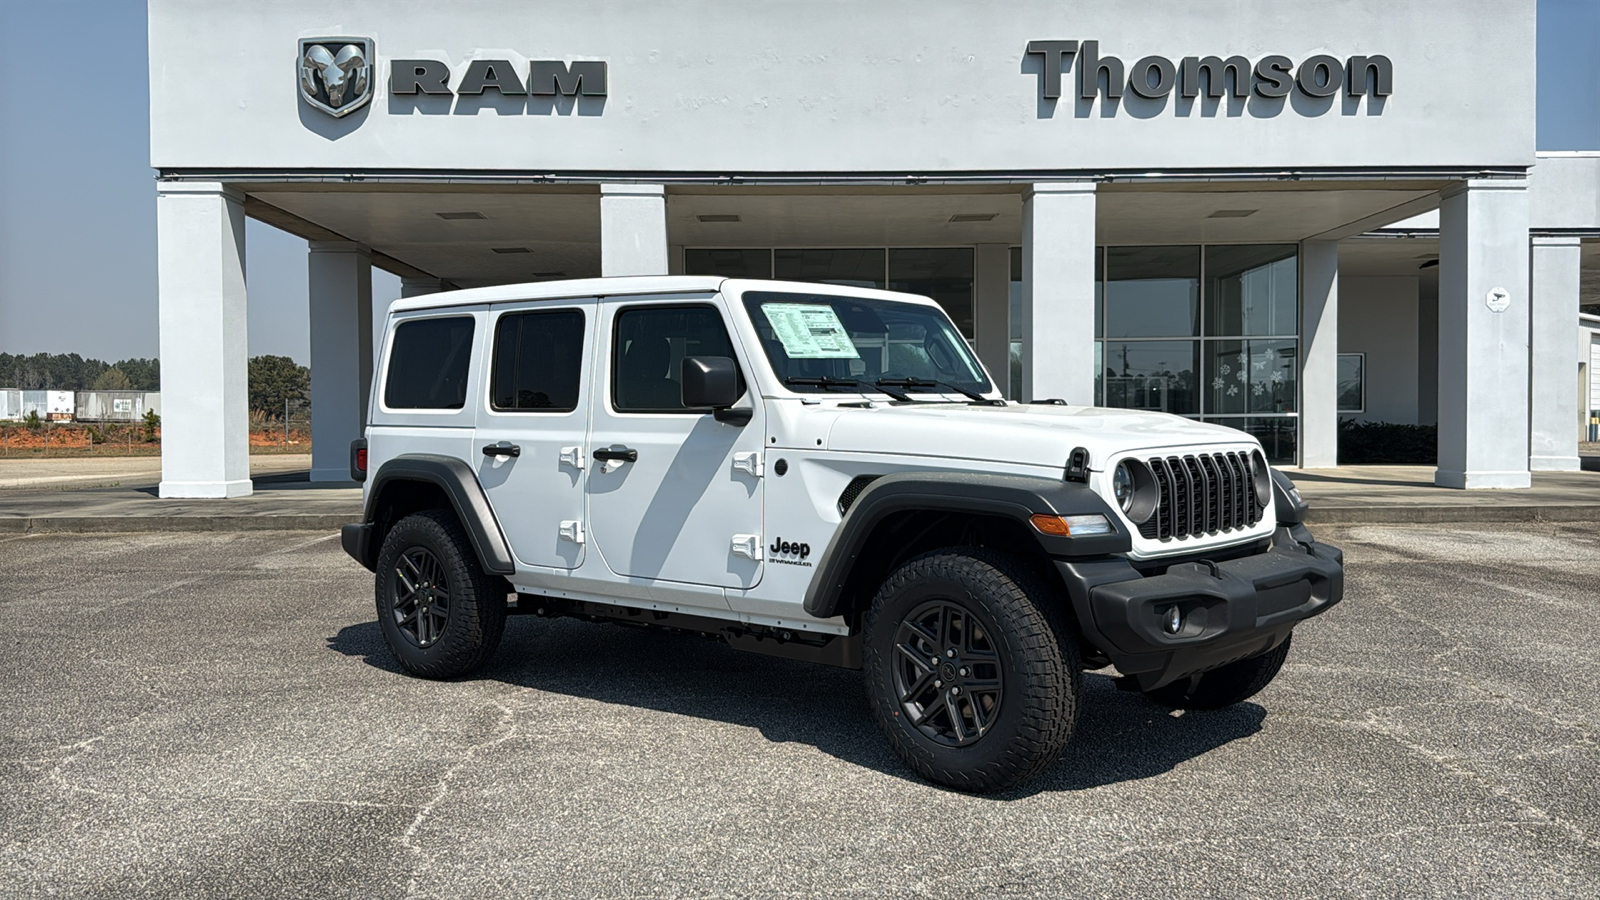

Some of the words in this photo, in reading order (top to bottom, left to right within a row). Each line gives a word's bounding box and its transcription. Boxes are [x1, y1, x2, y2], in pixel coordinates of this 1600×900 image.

[390, 59, 607, 96] RAM
[1027, 40, 1393, 99] Thomson
[770, 536, 811, 559] Jeep
[775, 559, 812, 567] WRANGLER
